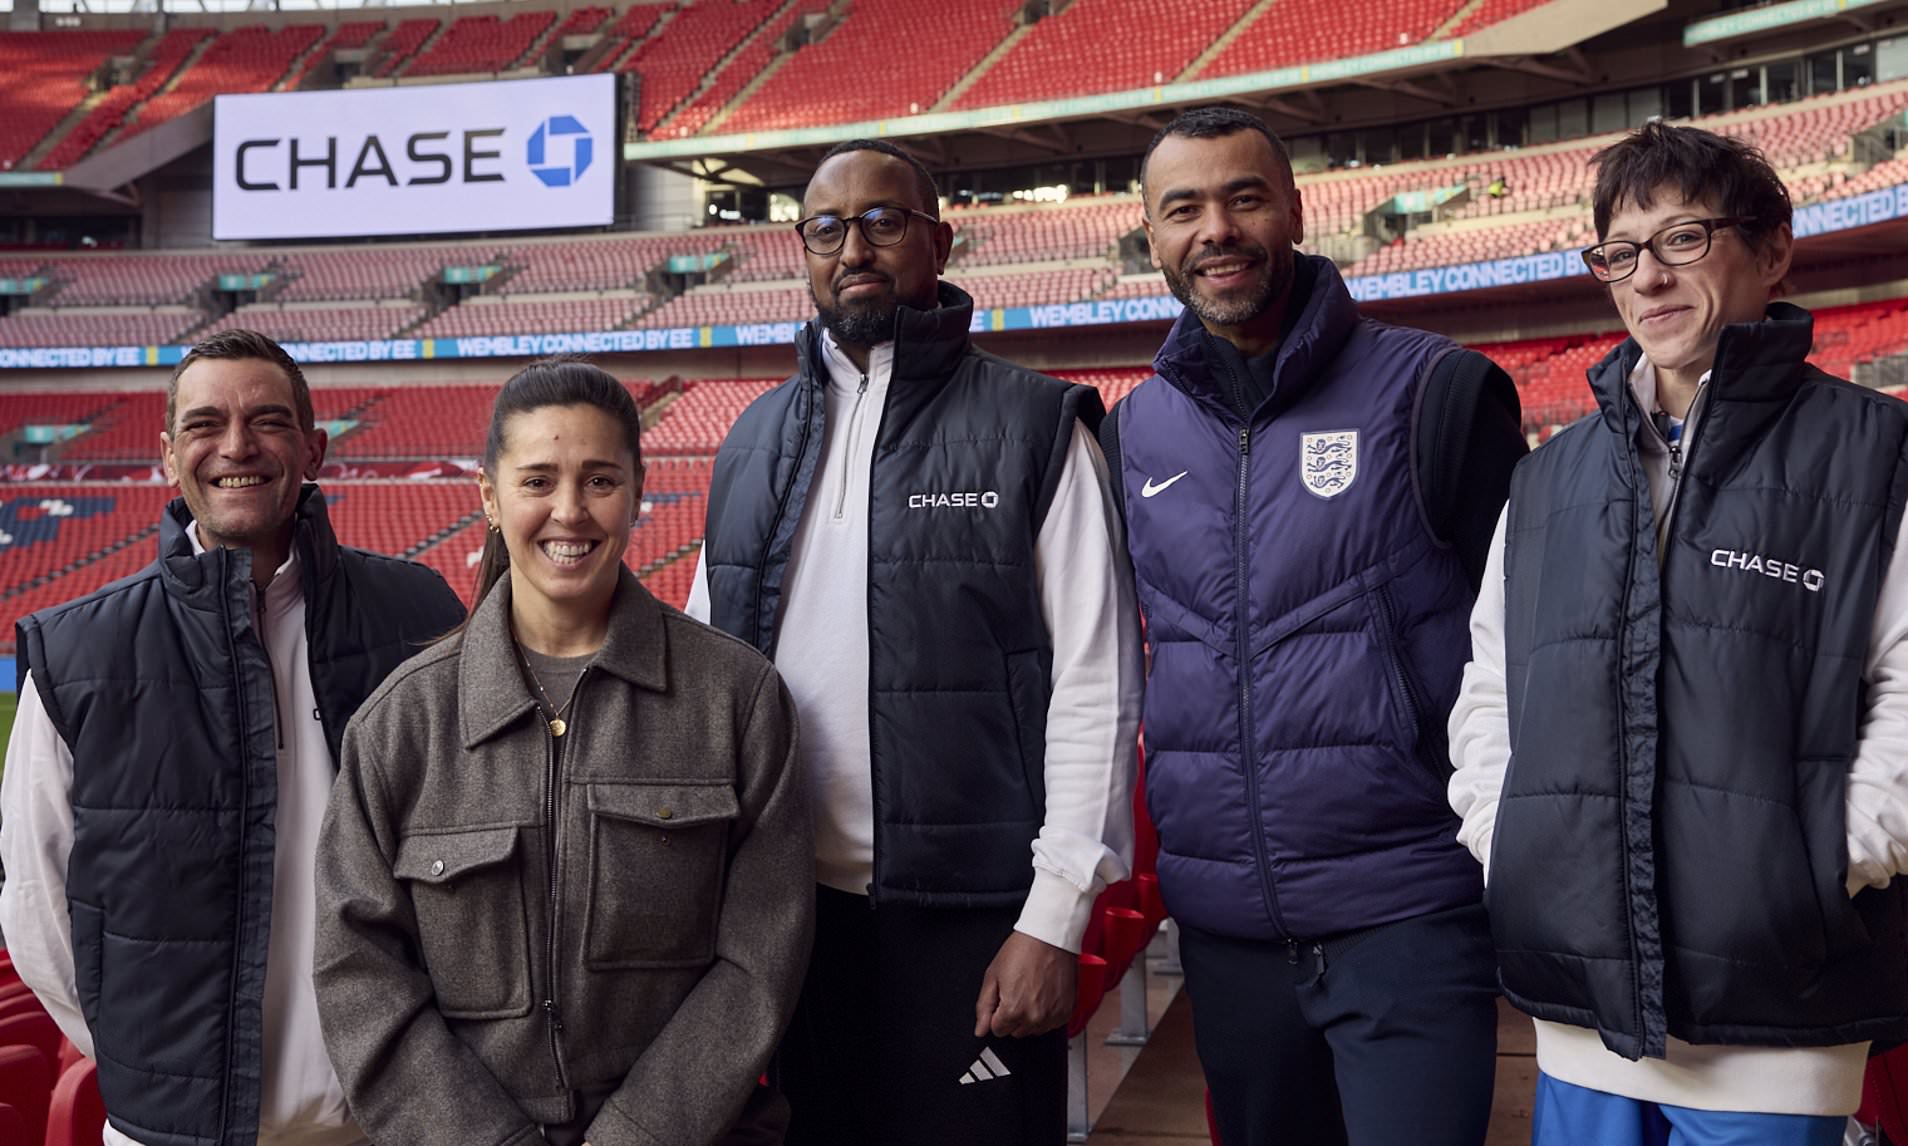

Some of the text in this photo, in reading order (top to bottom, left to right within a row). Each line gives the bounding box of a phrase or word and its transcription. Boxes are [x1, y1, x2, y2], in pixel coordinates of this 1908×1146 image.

[236, 127, 506, 191] CHASE
[1792, 187, 1895, 239] NNECTED
[1344, 269, 1446, 301] WEMBLEY
[1445, 252, 1564, 290] CONNECTED
[1030, 300, 1125, 327] WEMBLEY
[0, 346, 139, 367] ONNECTED BY EE
[279, 339, 416, 362] NNECTED BY EE
[457, 328, 692, 357] WEMBLEY CONNECTED BY EE
[908, 493, 978, 508] CHASE
[1710, 549, 1800, 583] CHASE
